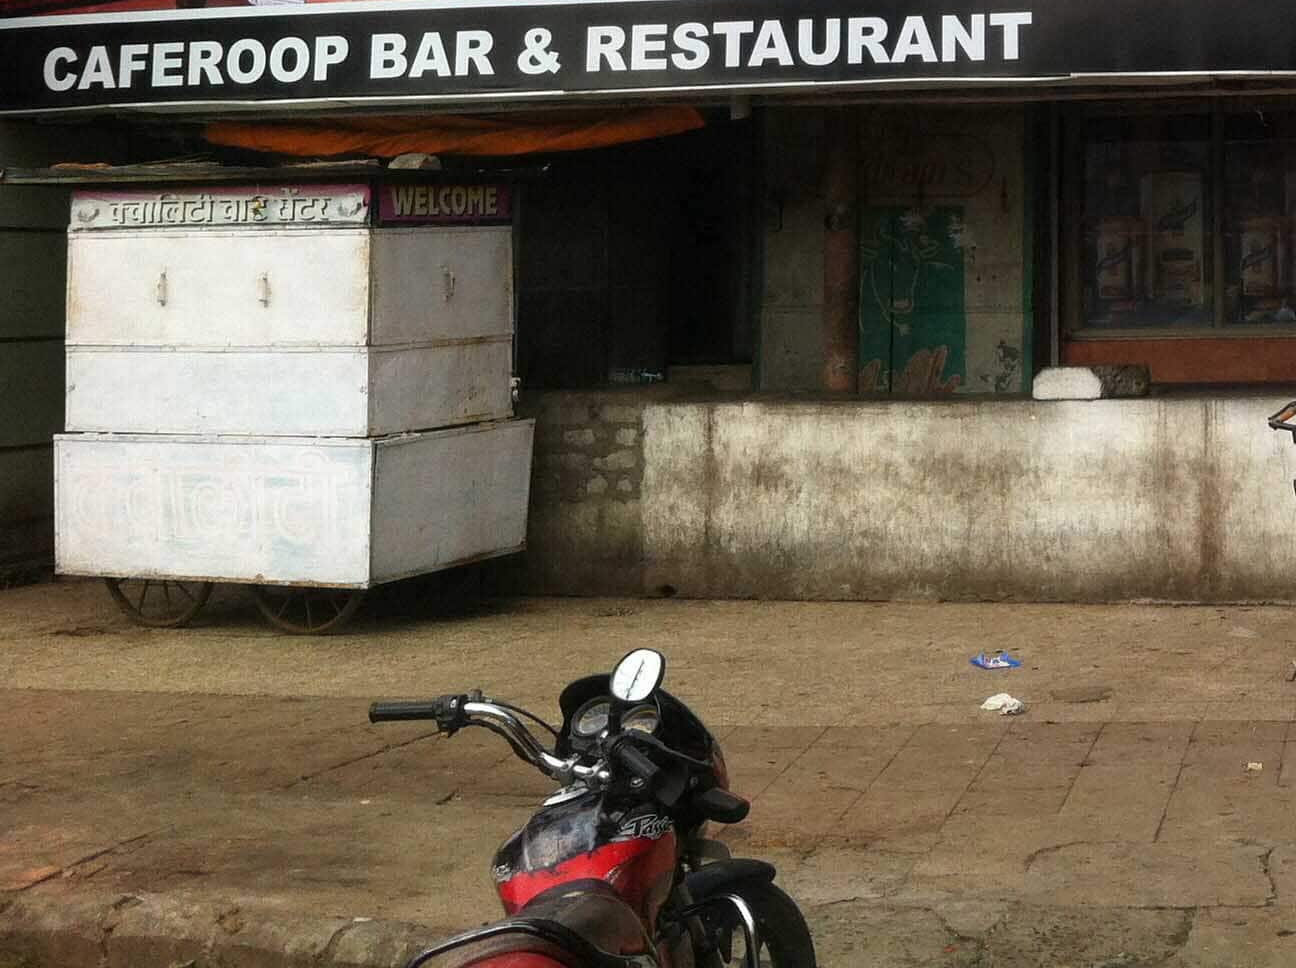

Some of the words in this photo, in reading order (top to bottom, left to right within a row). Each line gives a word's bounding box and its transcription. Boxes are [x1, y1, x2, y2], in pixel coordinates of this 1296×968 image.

[42, 34, 349, 93] CAFEROOP
[371, 27, 495, 80] BAR
[516, 25, 561, 75] &
[586, 11, 1033, 72] RESTAURANT
[390, 186, 498, 219] WELCOME
